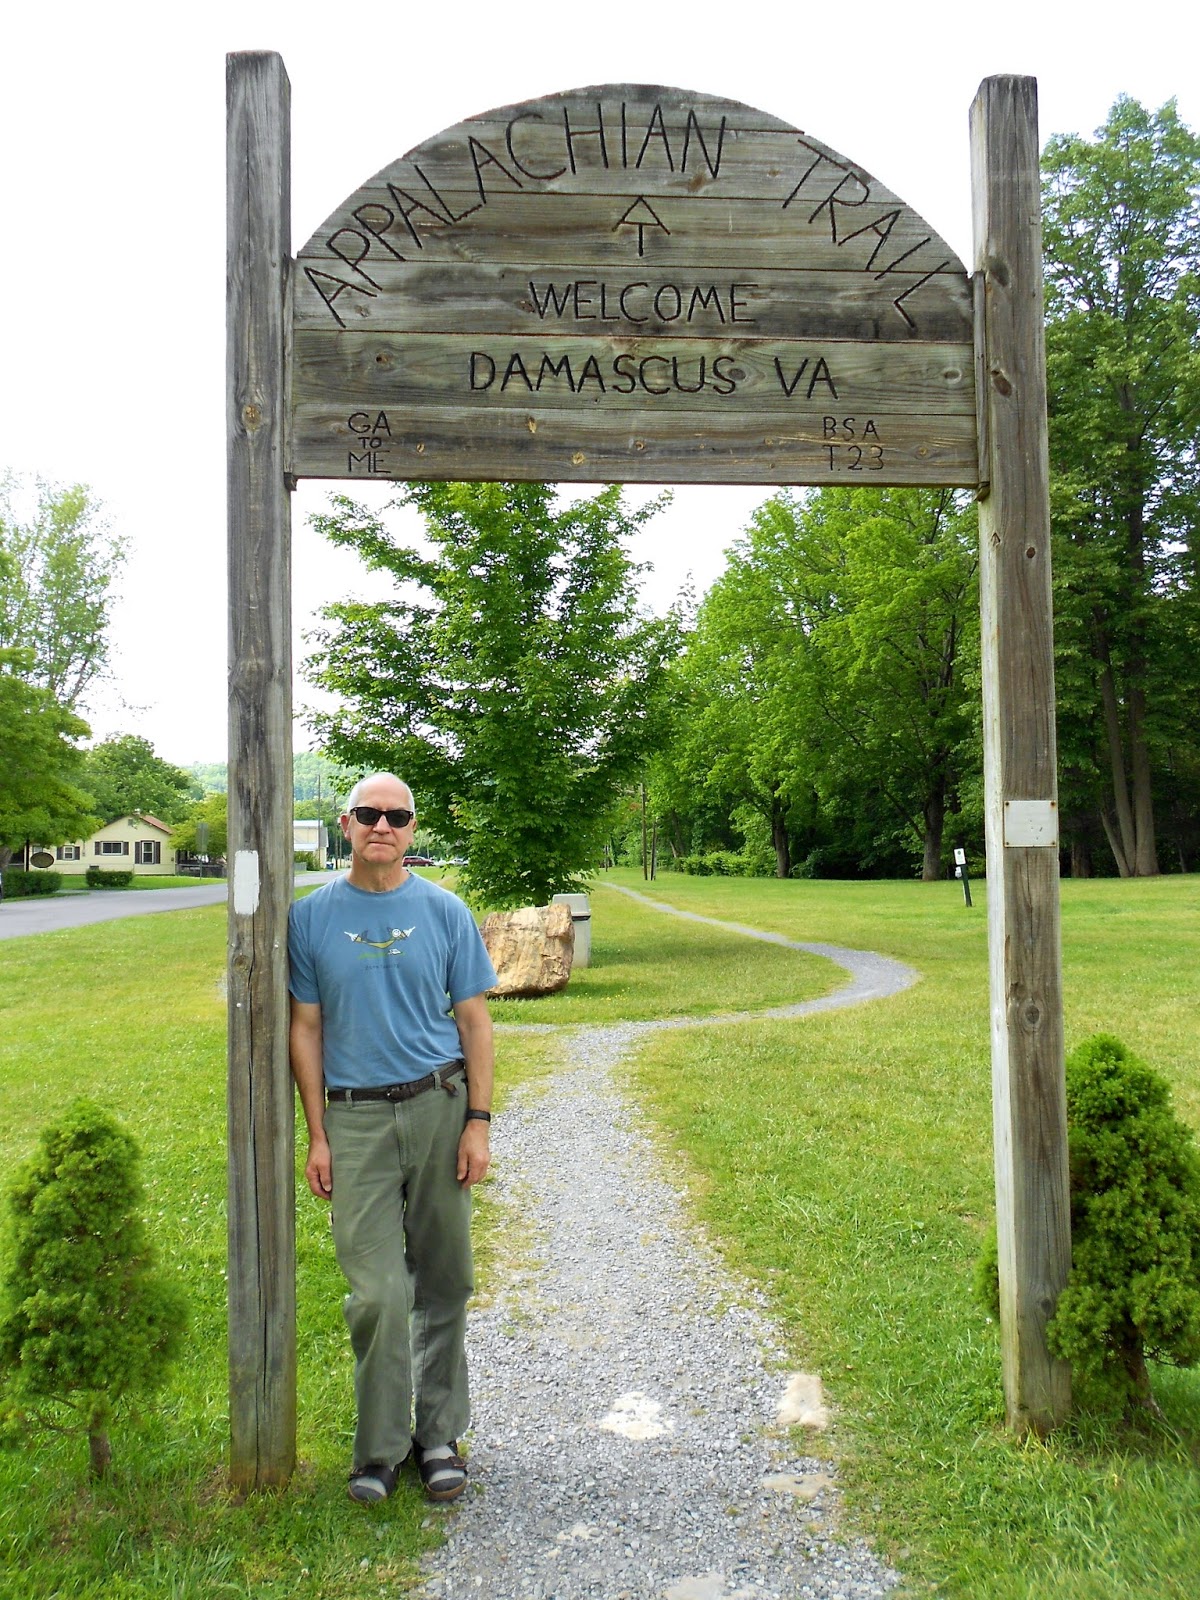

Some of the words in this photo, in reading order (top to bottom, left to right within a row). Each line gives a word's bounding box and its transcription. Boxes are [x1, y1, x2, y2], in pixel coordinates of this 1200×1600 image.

[304, 102, 727, 329] APPALACHIAN
[782, 138, 951, 329] TRAIL
[529, 280, 758, 324] WELCOME
[470, 351, 737, 396] DAMASCUS
[774, 356, 839, 400] VA
[347, 410, 392, 437] GA
[823, 416, 880, 441] BSA
[358, 437, 382, 449] TO
[347, 450, 391, 474] ME
